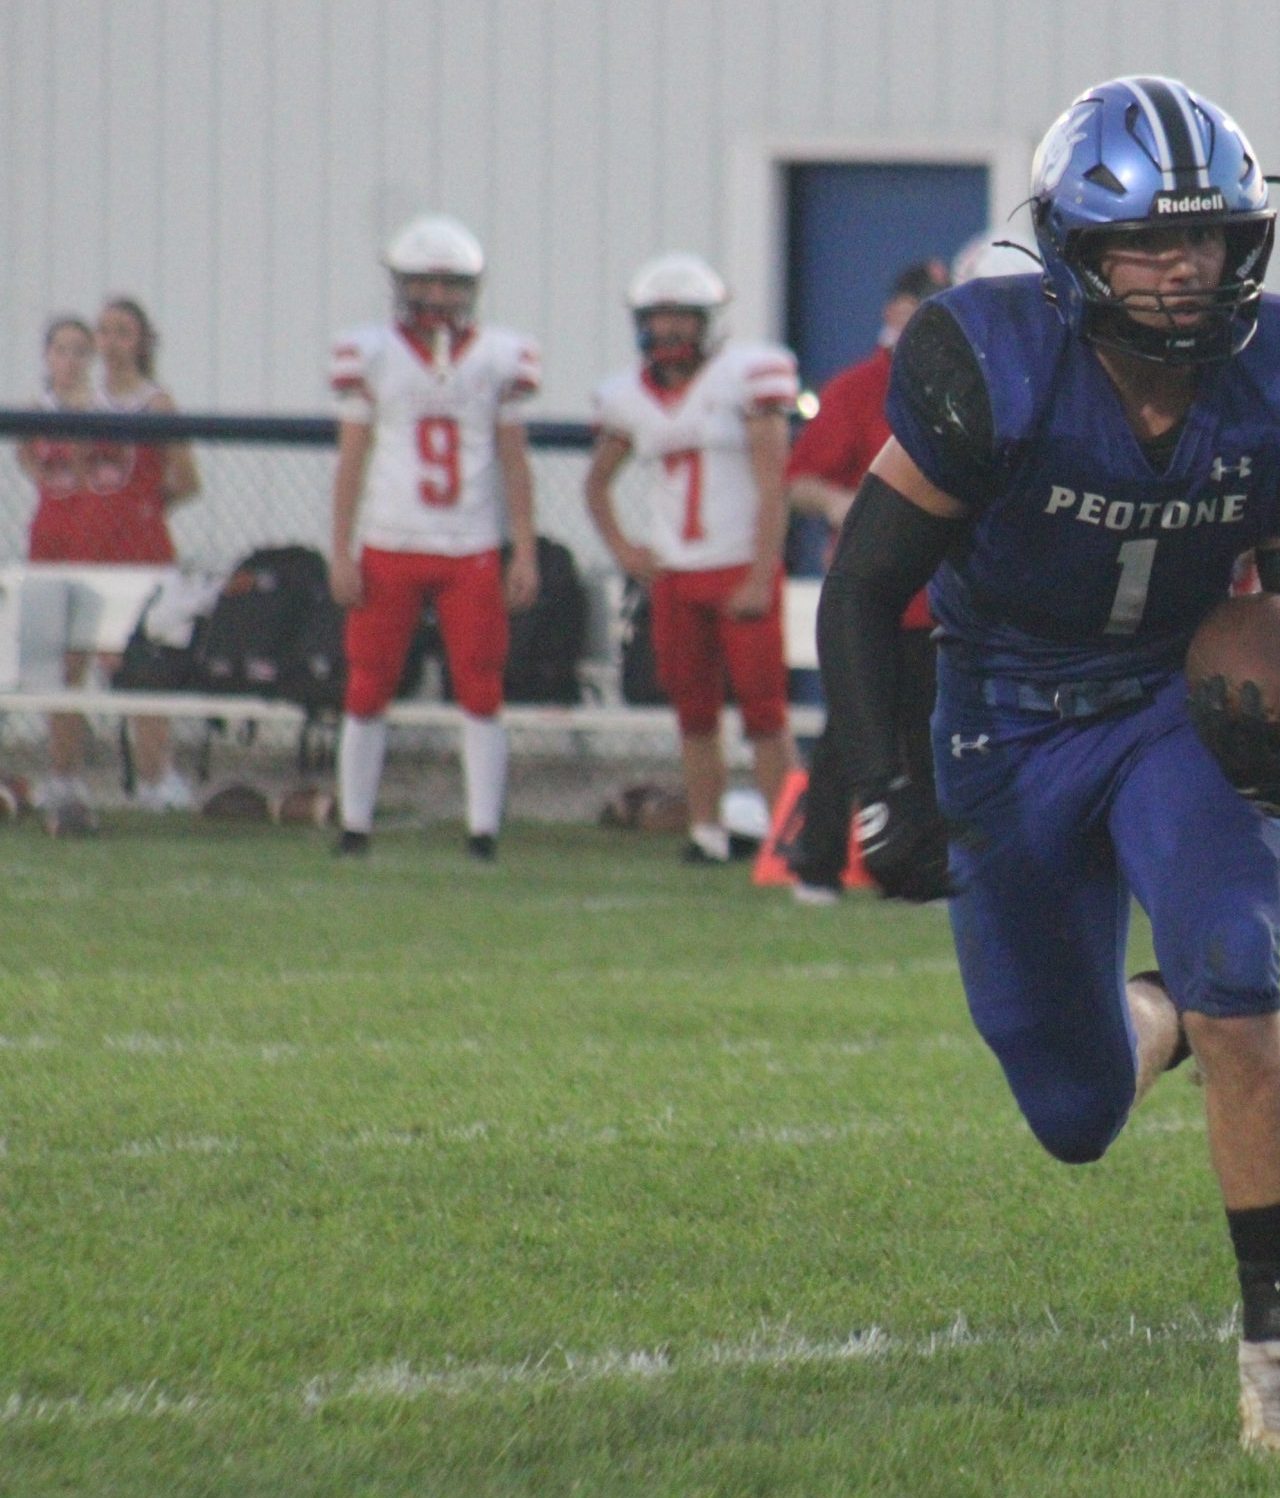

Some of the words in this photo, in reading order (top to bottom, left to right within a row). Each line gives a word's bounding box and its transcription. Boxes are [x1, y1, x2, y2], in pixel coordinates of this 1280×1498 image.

[1158, 194, 1223, 213] Riddell
[416, 415, 461, 508] 9
[663, 448, 705, 541] 7
[1044, 485, 1248, 531] PEOTONE
[1103, 538, 1159, 635] 1
